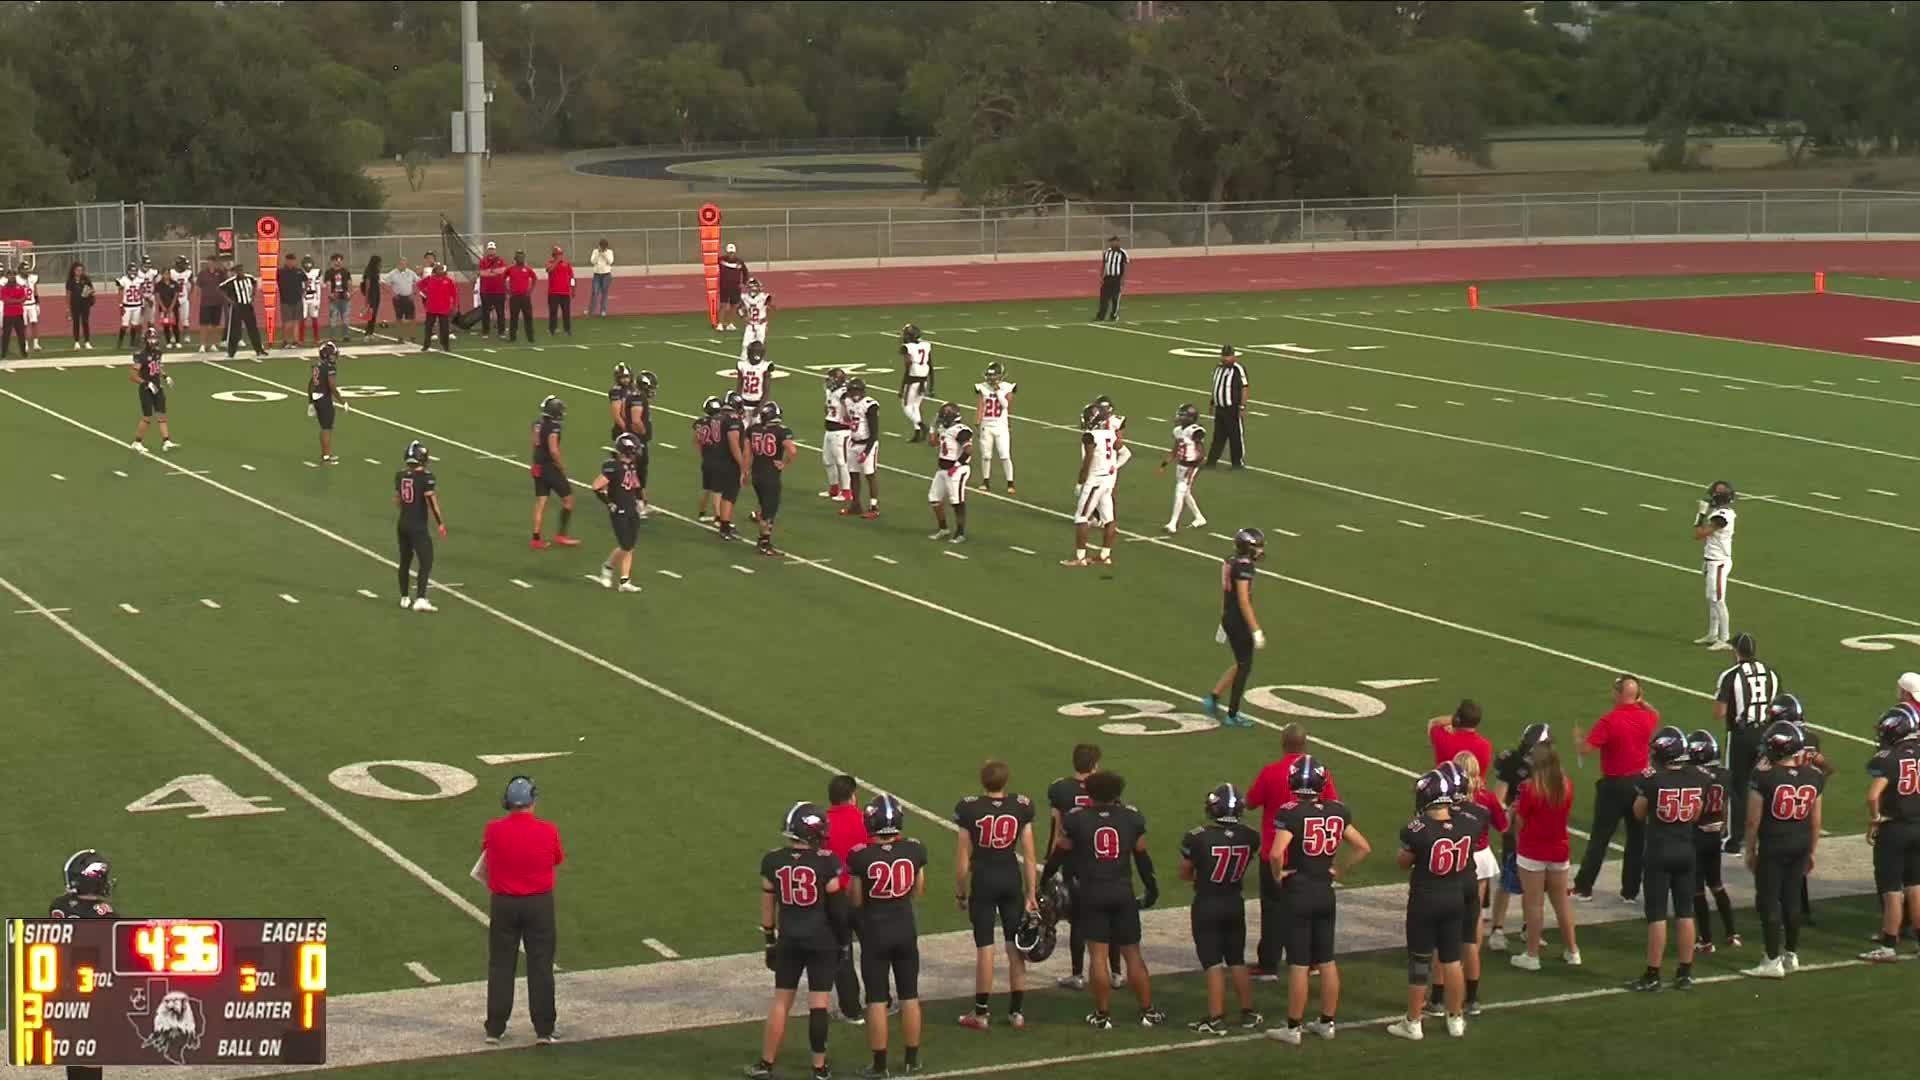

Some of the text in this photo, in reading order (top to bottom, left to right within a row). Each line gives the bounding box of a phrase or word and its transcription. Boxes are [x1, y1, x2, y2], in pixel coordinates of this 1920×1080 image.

[218, 231, 232, 250] 3
[918, 349, 926, 365] 7
[743, 376, 759, 394] 32
[751, 433, 777, 457] 56
[1105, 438, 1113, 460] 5
[401, 478, 414, 504] 5
[1747, 676, 1767, 704] H
[1656, 788, 1703, 823] 55
[1771, 784, 1817, 821] 63
[976, 814, 1018, 849] 19
[1094, 826, 1120, 860] 9
[1303, 816, 1345, 857] 53
[1210, 845, 1250, 883] 77
[1429, 836, 1472, 877] 61
[776, 865, 817, 907] 13
[868, 858, 915, 899] 20
